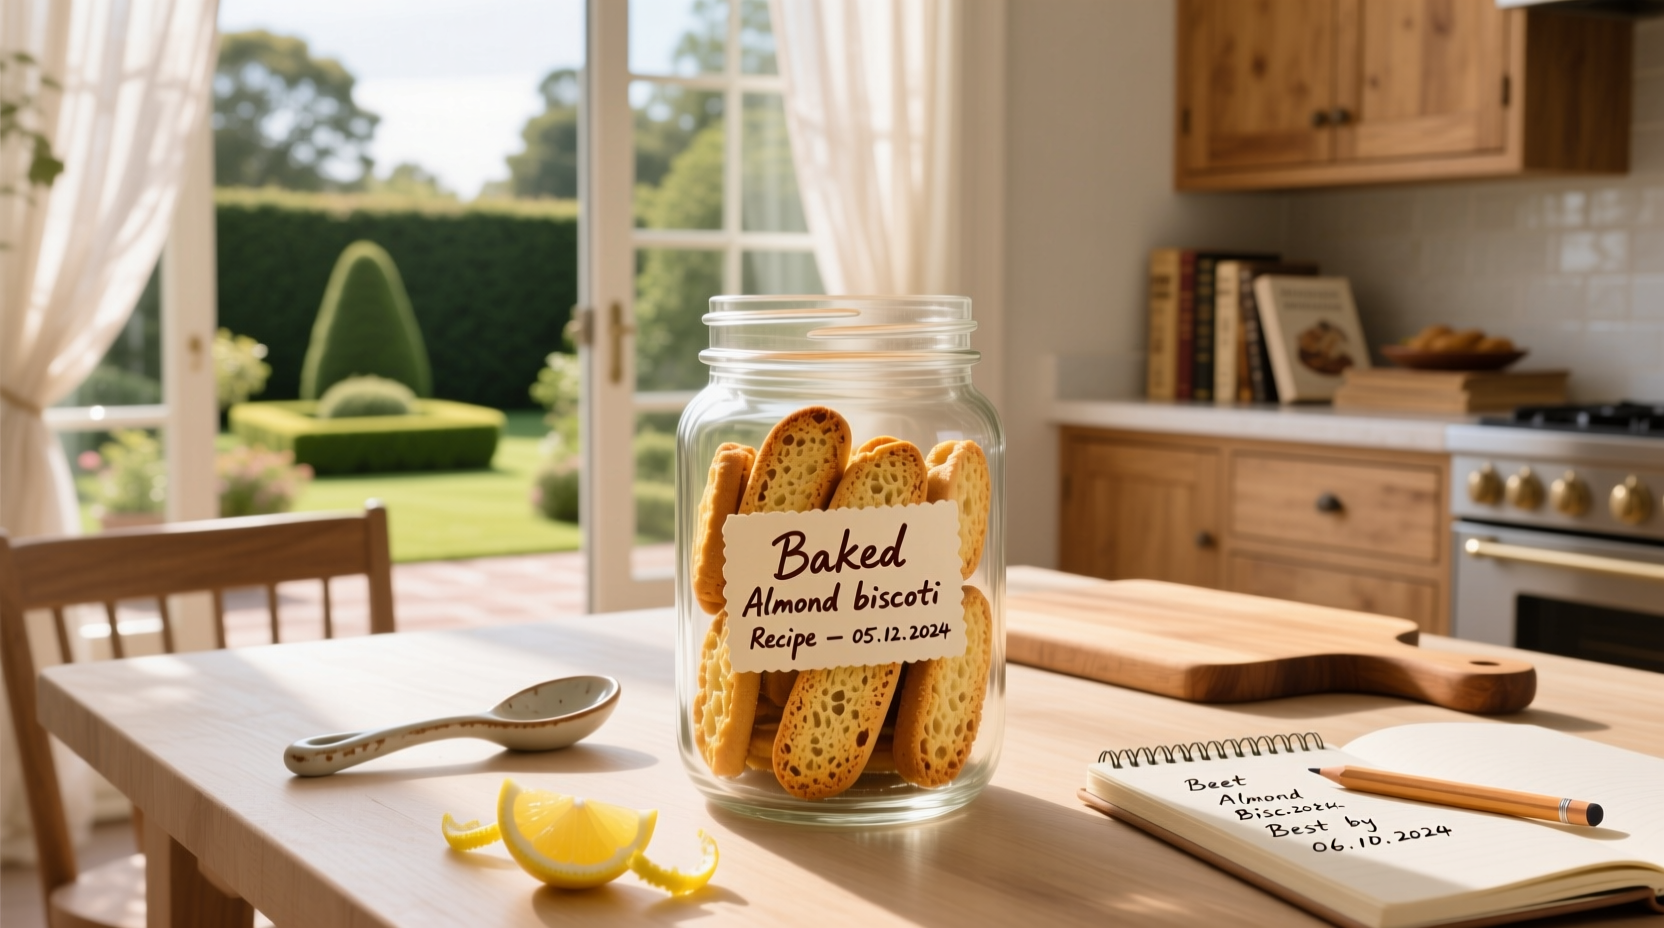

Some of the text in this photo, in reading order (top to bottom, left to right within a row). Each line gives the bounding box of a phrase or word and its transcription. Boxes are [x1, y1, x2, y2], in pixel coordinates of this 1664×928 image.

[771, 522, 908, 580] Baked
[742, 579, 941, 618] Almond biscoti
[750, 626, 817, 661] Recipe
[852, 621, 952, 644] 05.12.2024
[1218, 788, 1304, 805] Almond
[1265, 815, 1378, 838] Best by
[1312, 825, 1453, 853] 06.10.2024
